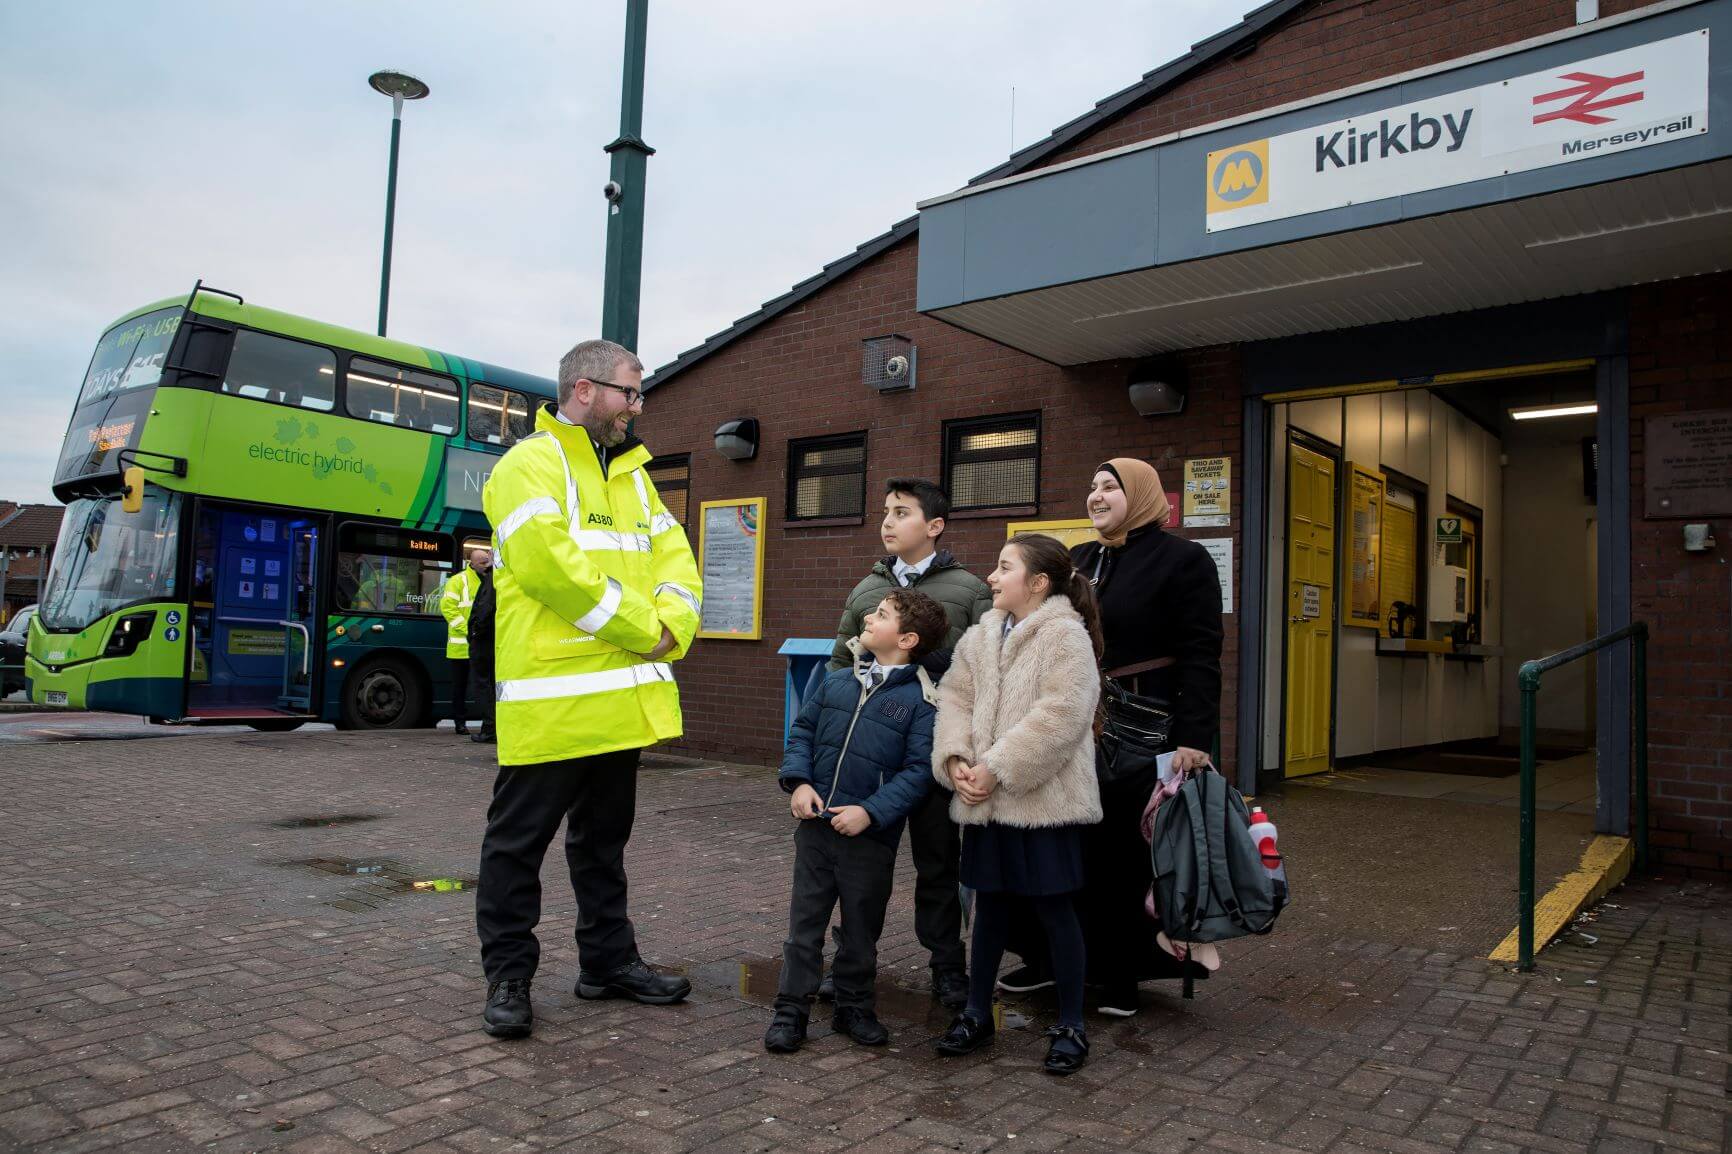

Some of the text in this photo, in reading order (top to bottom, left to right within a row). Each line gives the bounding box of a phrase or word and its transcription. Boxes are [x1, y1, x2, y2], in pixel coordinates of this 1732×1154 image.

[1315, 107, 1474, 173] Kirkby
[1561, 115, 1693, 156] Merseyrail
[154, 316, 181, 336] USB
[248, 441, 362, 473] electric hybrid
[587, 512, 613, 527] A380
[410, 539, 423, 550] Rail
[406, 591, 424, 604] free
